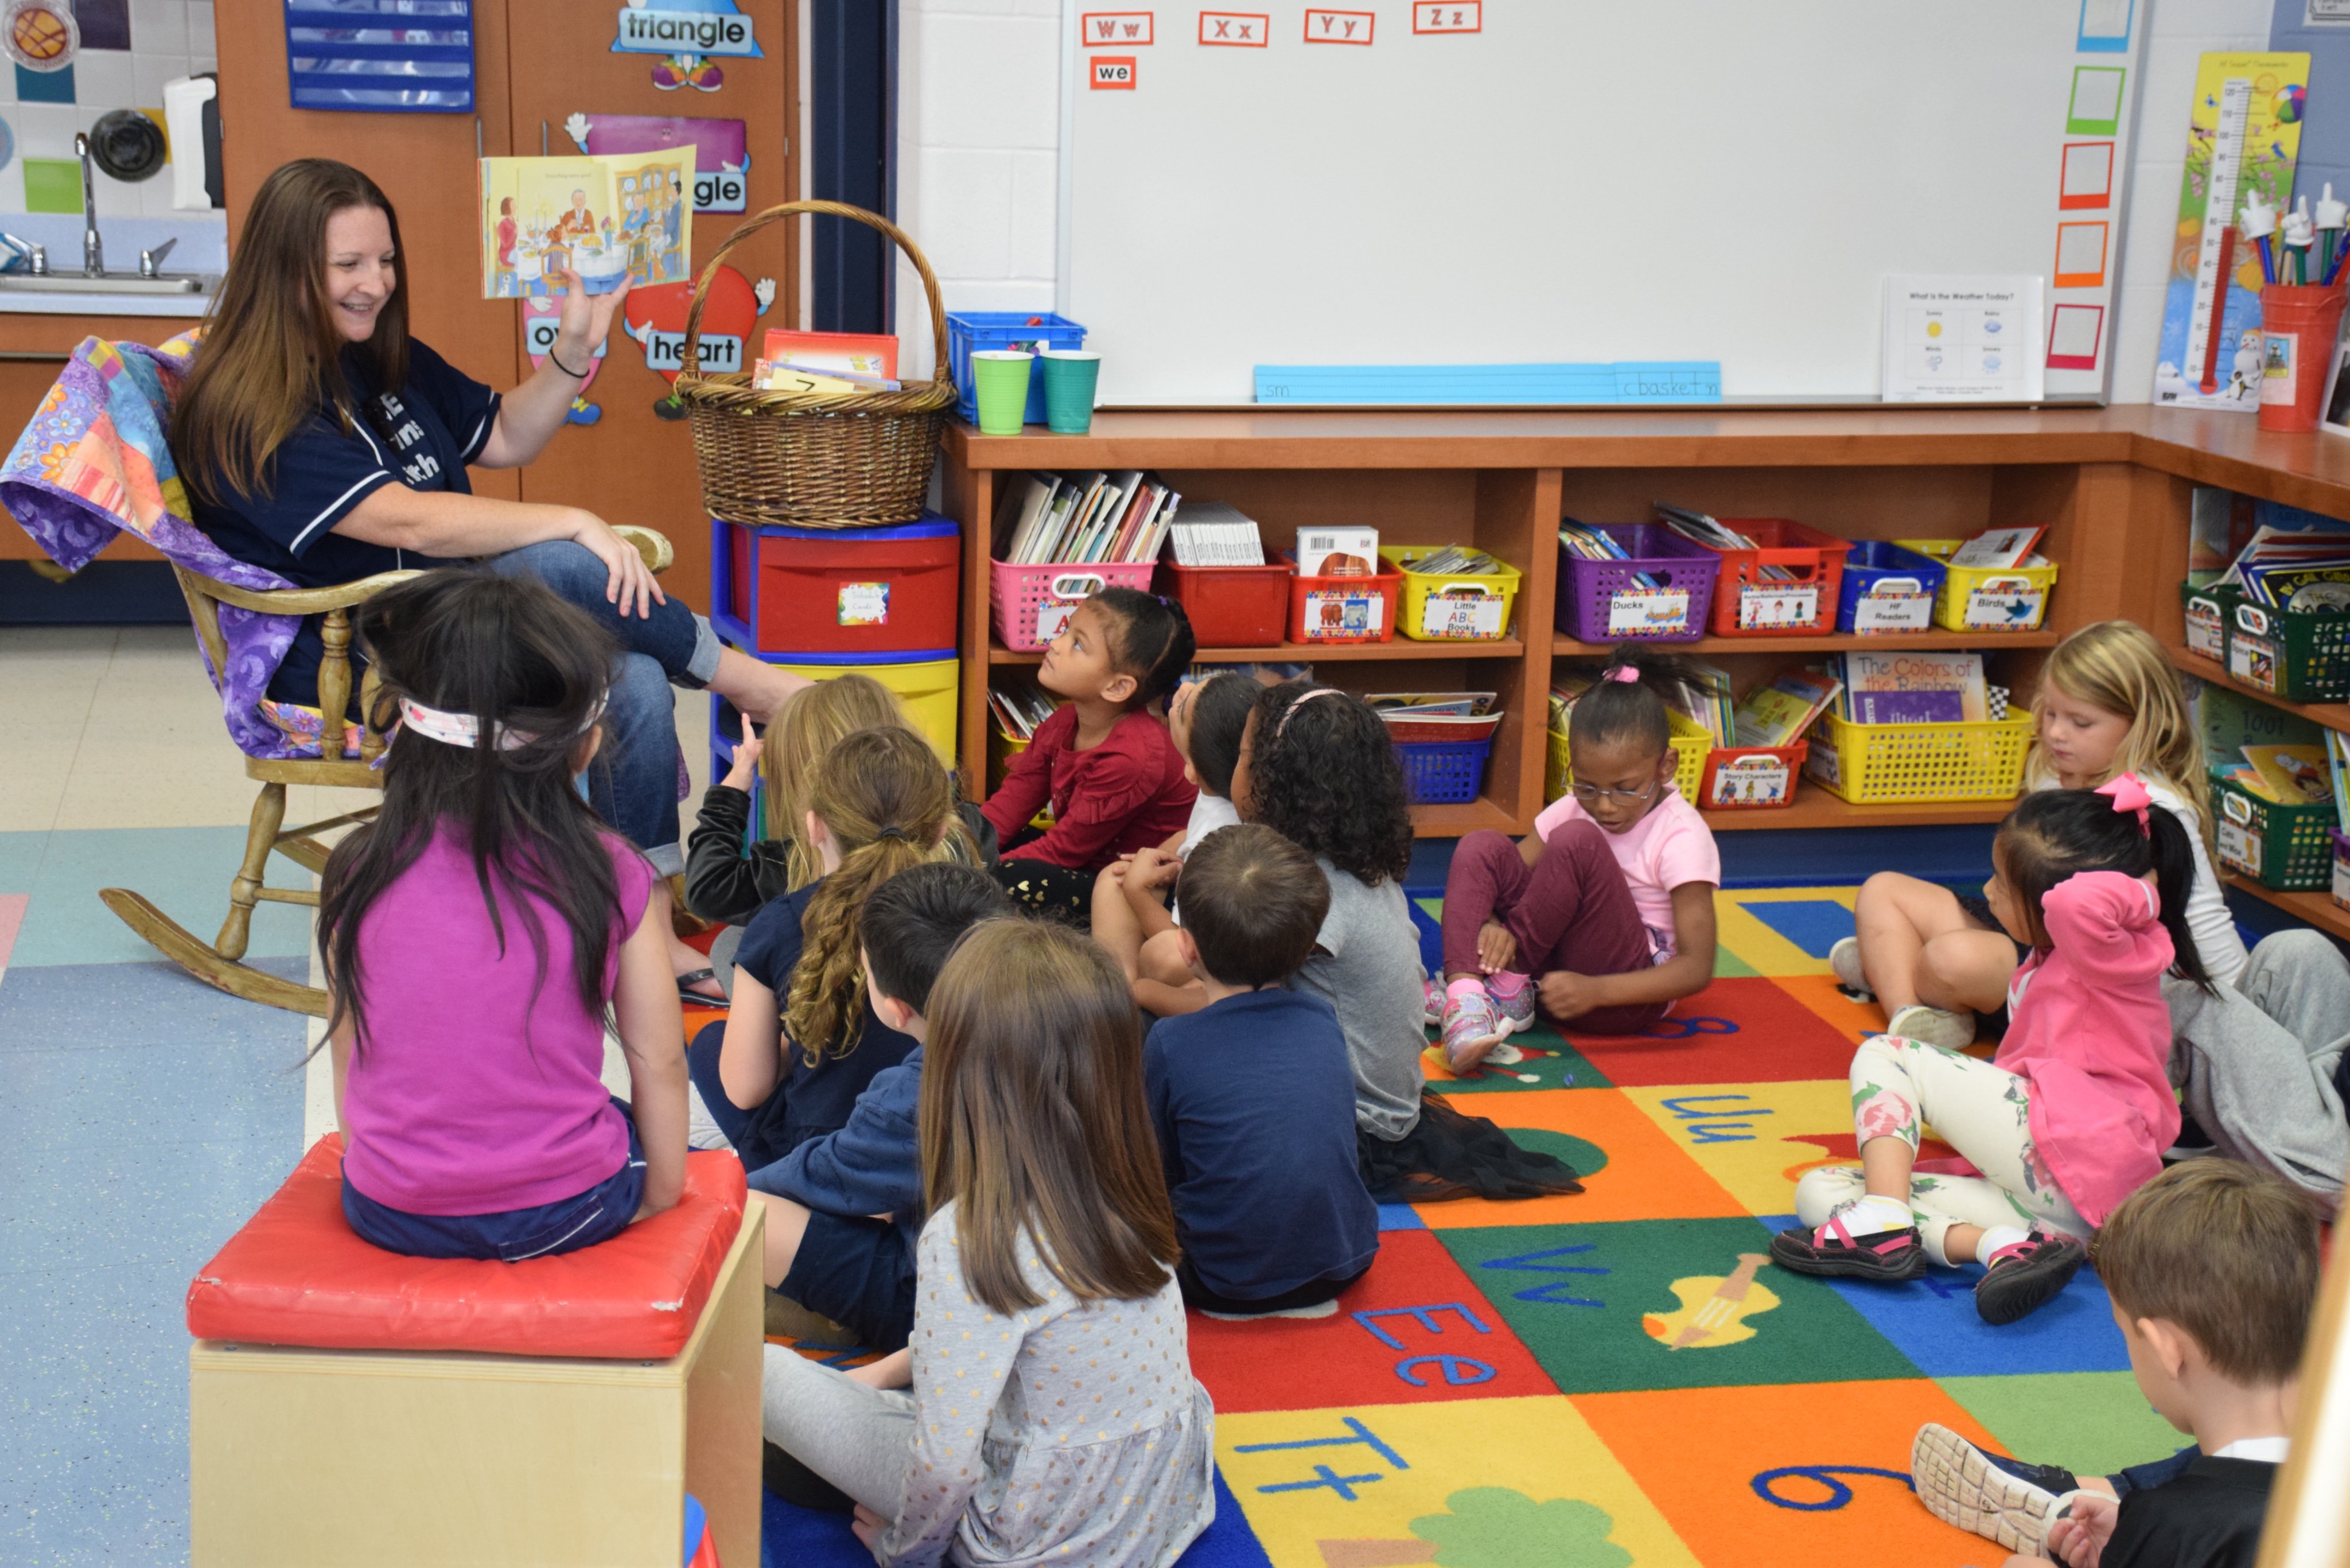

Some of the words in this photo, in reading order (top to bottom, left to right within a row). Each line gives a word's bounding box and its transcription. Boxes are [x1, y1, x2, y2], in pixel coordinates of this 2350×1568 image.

[628, 13, 745, 49] triangle
[1099, 67, 1128, 80] we
[1986, 293, 2014, 301] Today?
[1265, 384, 1290, 398] sm
[1613, 601, 1644, 610] Ducks
[1977, 598, 2005, 608] Birds
[1448, 612, 1477, 624] ABC
[1875, 613, 1911, 621] Readers
[1448, 623, 1476, 631] Books
[1857, 656, 1891, 676] The
[1894, 657, 1951, 677] Colors
[1955, 659, 1975, 678] of
[1865, 675, 1893, 692] the
[1895, 675, 1968, 694] Rainbow
[1724, 773, 1743, 781] Story
